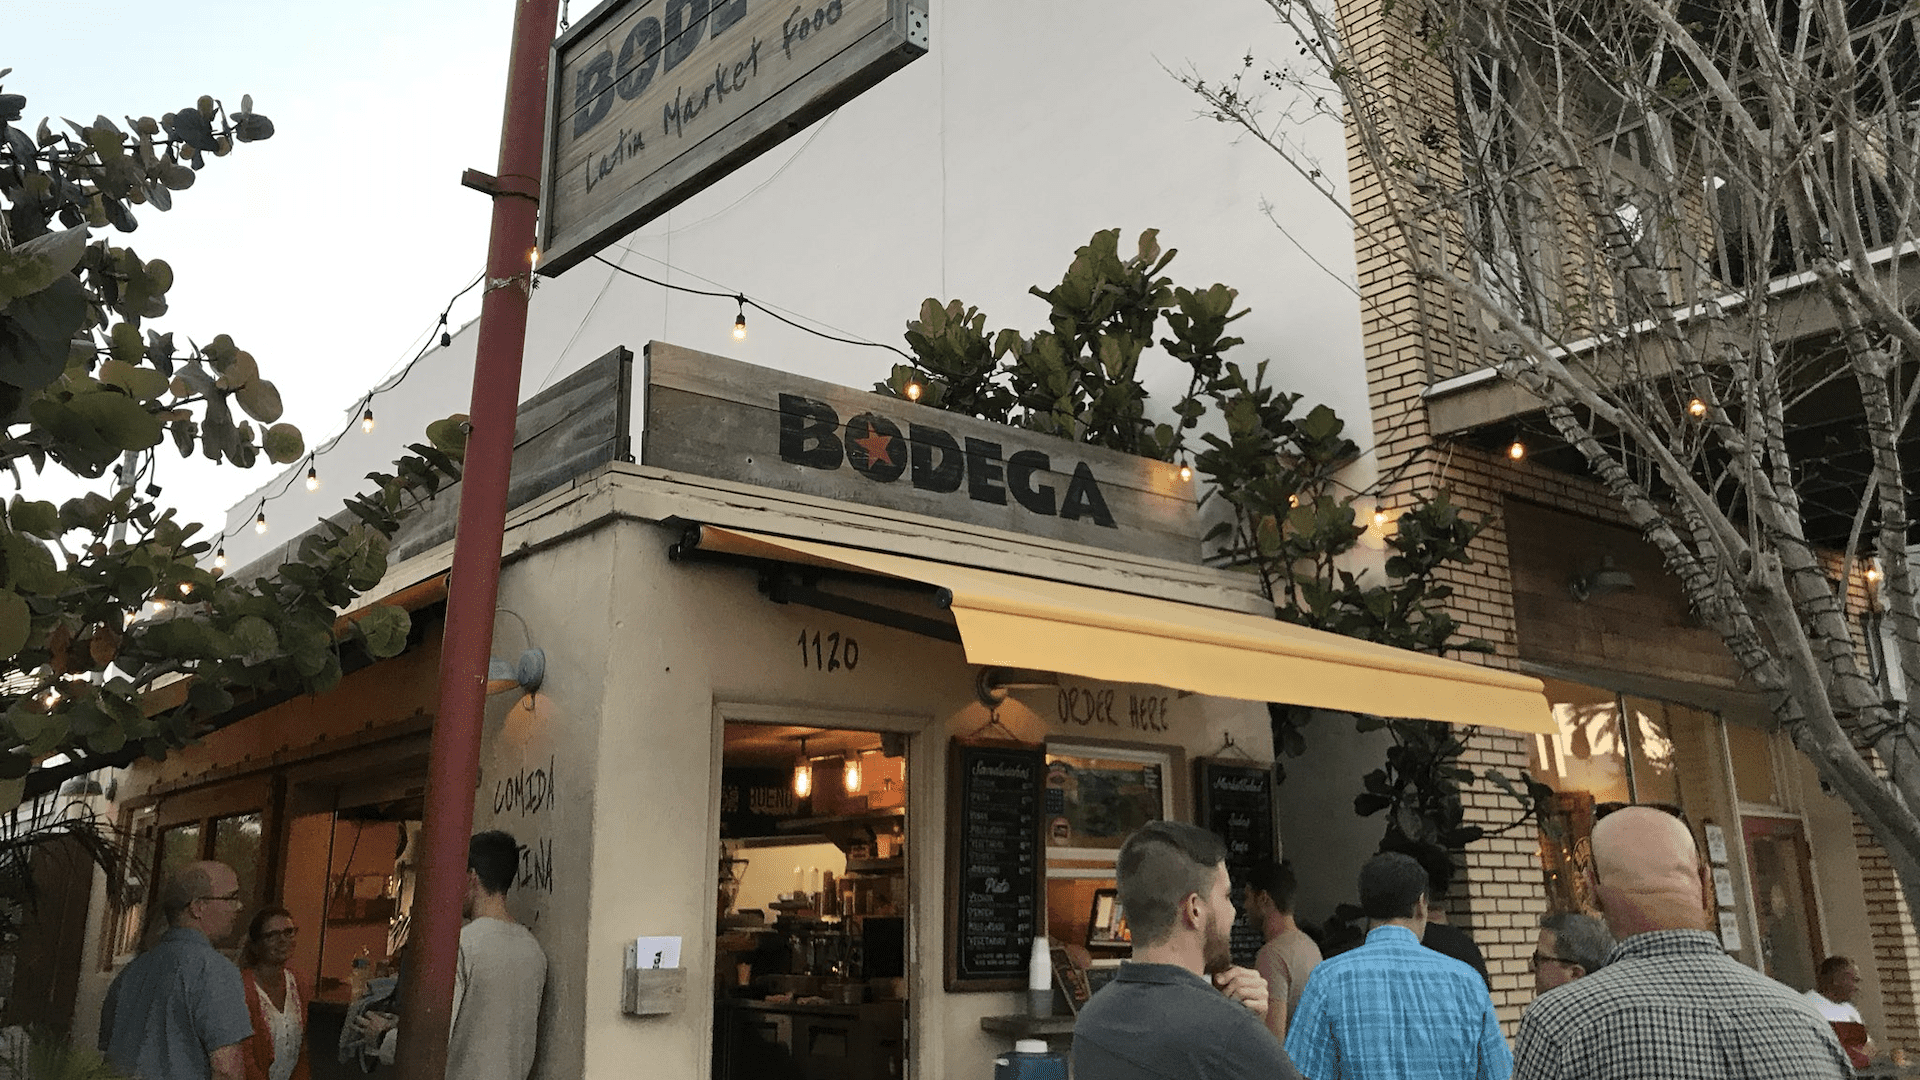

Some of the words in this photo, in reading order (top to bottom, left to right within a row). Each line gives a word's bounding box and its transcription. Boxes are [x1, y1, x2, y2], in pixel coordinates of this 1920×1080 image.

[585, 128, 645, 194] Latin
[663, 36, 763, 138] Market
[783, 0, 843, 60] Food
[779, 393, 1118, 529] BODEGA
[797, 629, 859, 673] 1120
[1058, 687, 1119, 726] ORDER
[1129, 694, 1169, 732] HERE
[494, 754, 555, 818] COMIDA
